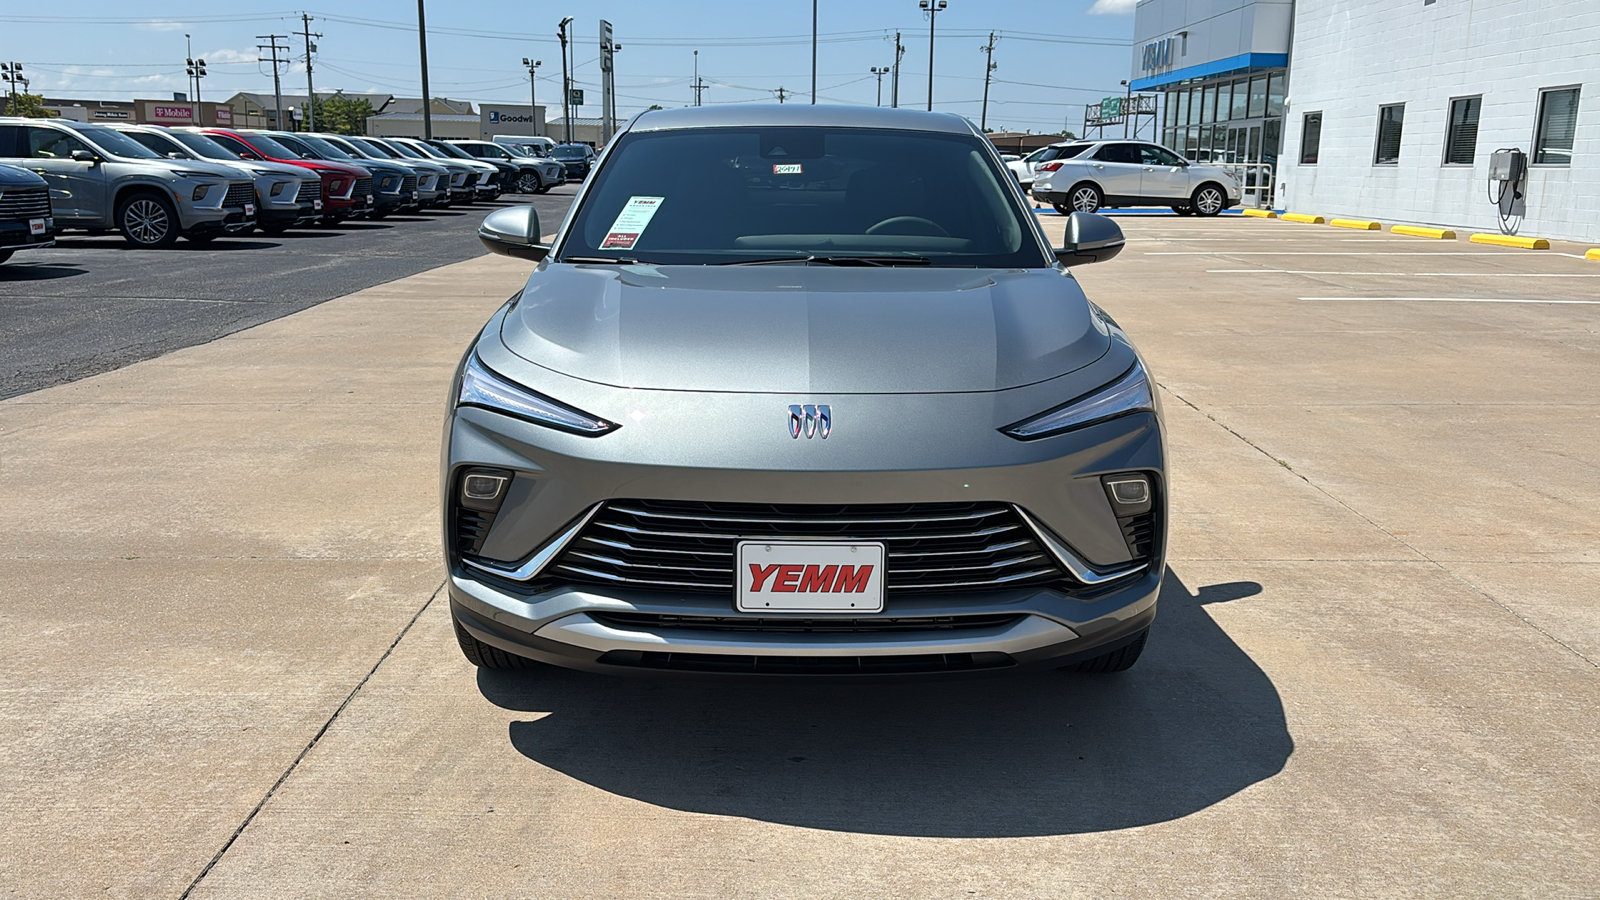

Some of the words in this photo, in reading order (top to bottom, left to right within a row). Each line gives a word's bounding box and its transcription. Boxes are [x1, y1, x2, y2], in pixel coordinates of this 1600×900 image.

[1142, 38, 1173, 70] YEMM
[164, 108, 190, 117] Mobile
[500, 114, 533, 123] Goodwil
[748, 564, 875, 593] YEMM
